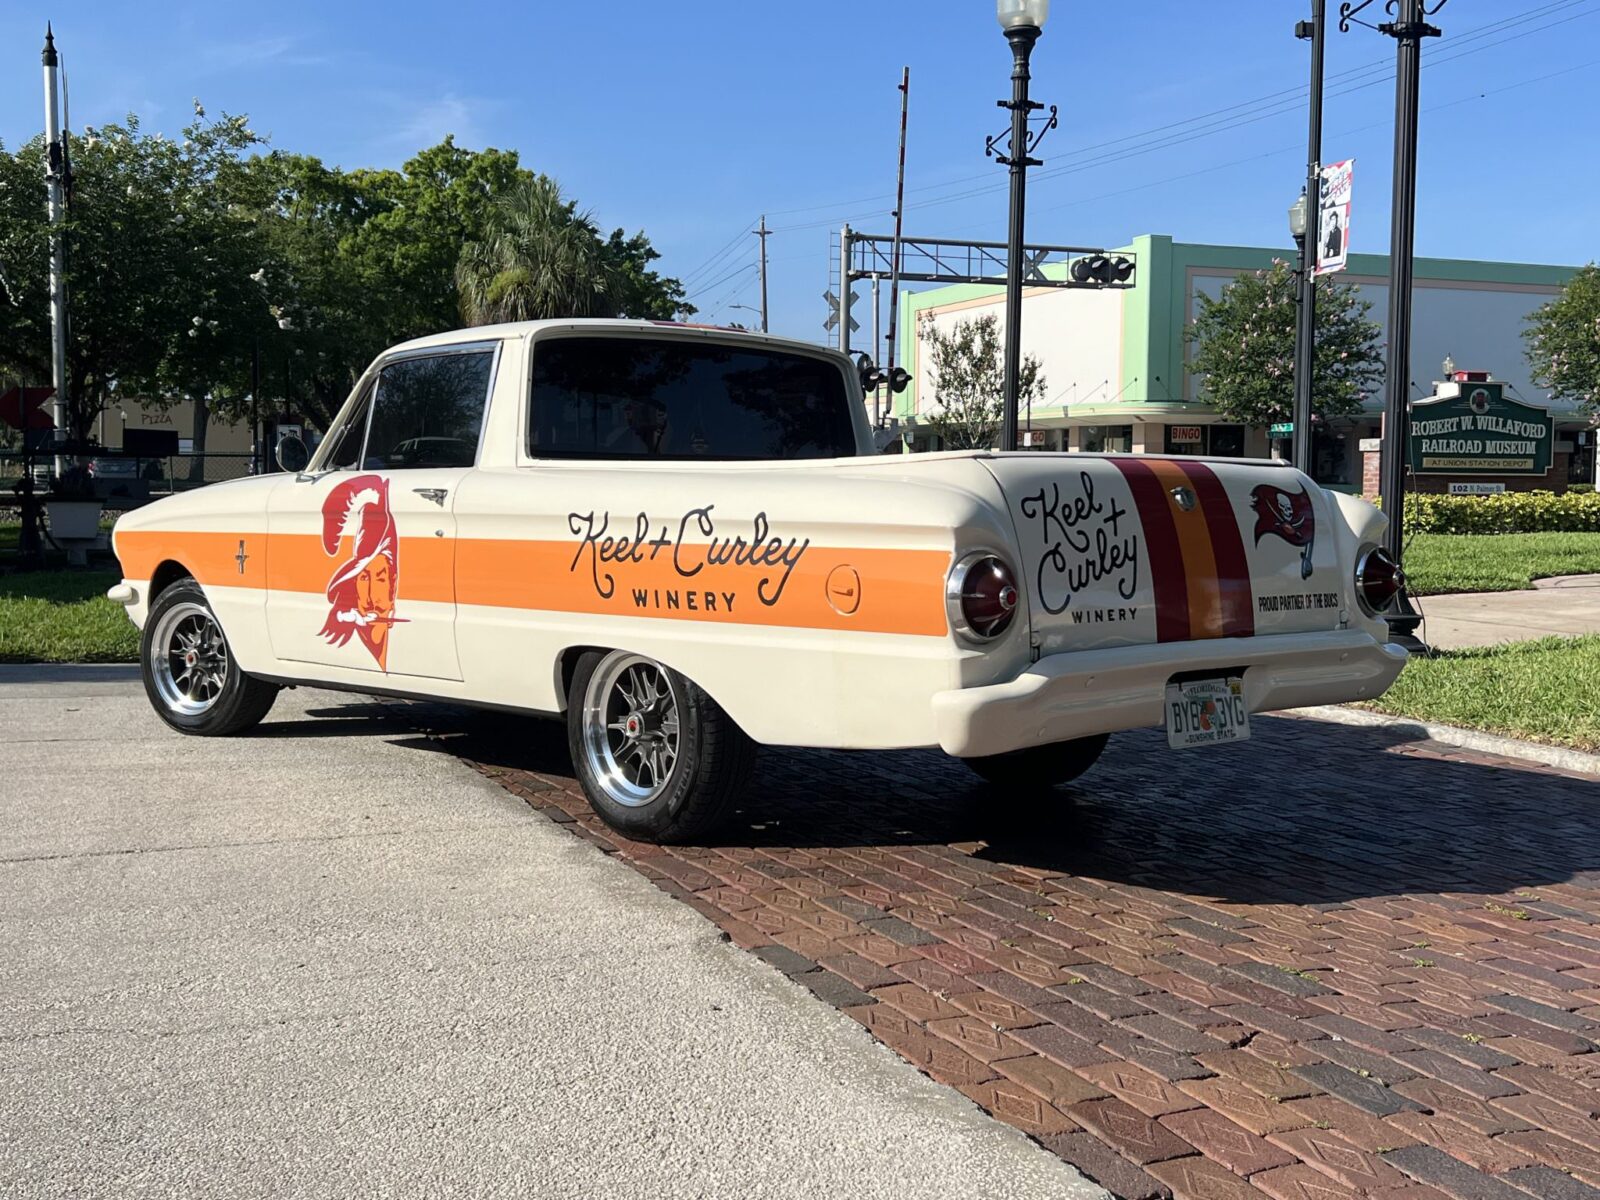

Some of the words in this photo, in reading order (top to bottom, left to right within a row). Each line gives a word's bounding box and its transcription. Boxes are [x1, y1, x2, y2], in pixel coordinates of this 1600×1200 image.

[141, 414, 172, 425] PIZZA
[1411, 418, 1459, 436] ROBERT
[1460, 415, 1474, 431] W.
[1476, 415, 1546, 439] WILLAFORD
[1172, 427, 1200, 440] BINGO
[1421, 439, 1482, 454] RAILROAD
[1485, 440, 1536, 455] MUSEUM
[1468, 460, 1501, 468] STATION
[1502, 460, 1528, 468] DEPOT
[1021, 471, 1103, 553] Keel
[568, 510, 649, 599] Keel
[673, 504, 810, 606] Curley
[1037, 527, 1138, 615] Curley
[632, 588, 736, 612] WINERY
[1258, 596, 1278, 612] PROUD
[1279, 594, 1304, 611] PARTNER
[1305, 594, 1312, 609] OF
[1313, 593, 1323, 608] THE
[1323, 593, 1338, 608] BUCS
[1071, 607, 1138, 624] WINERY
